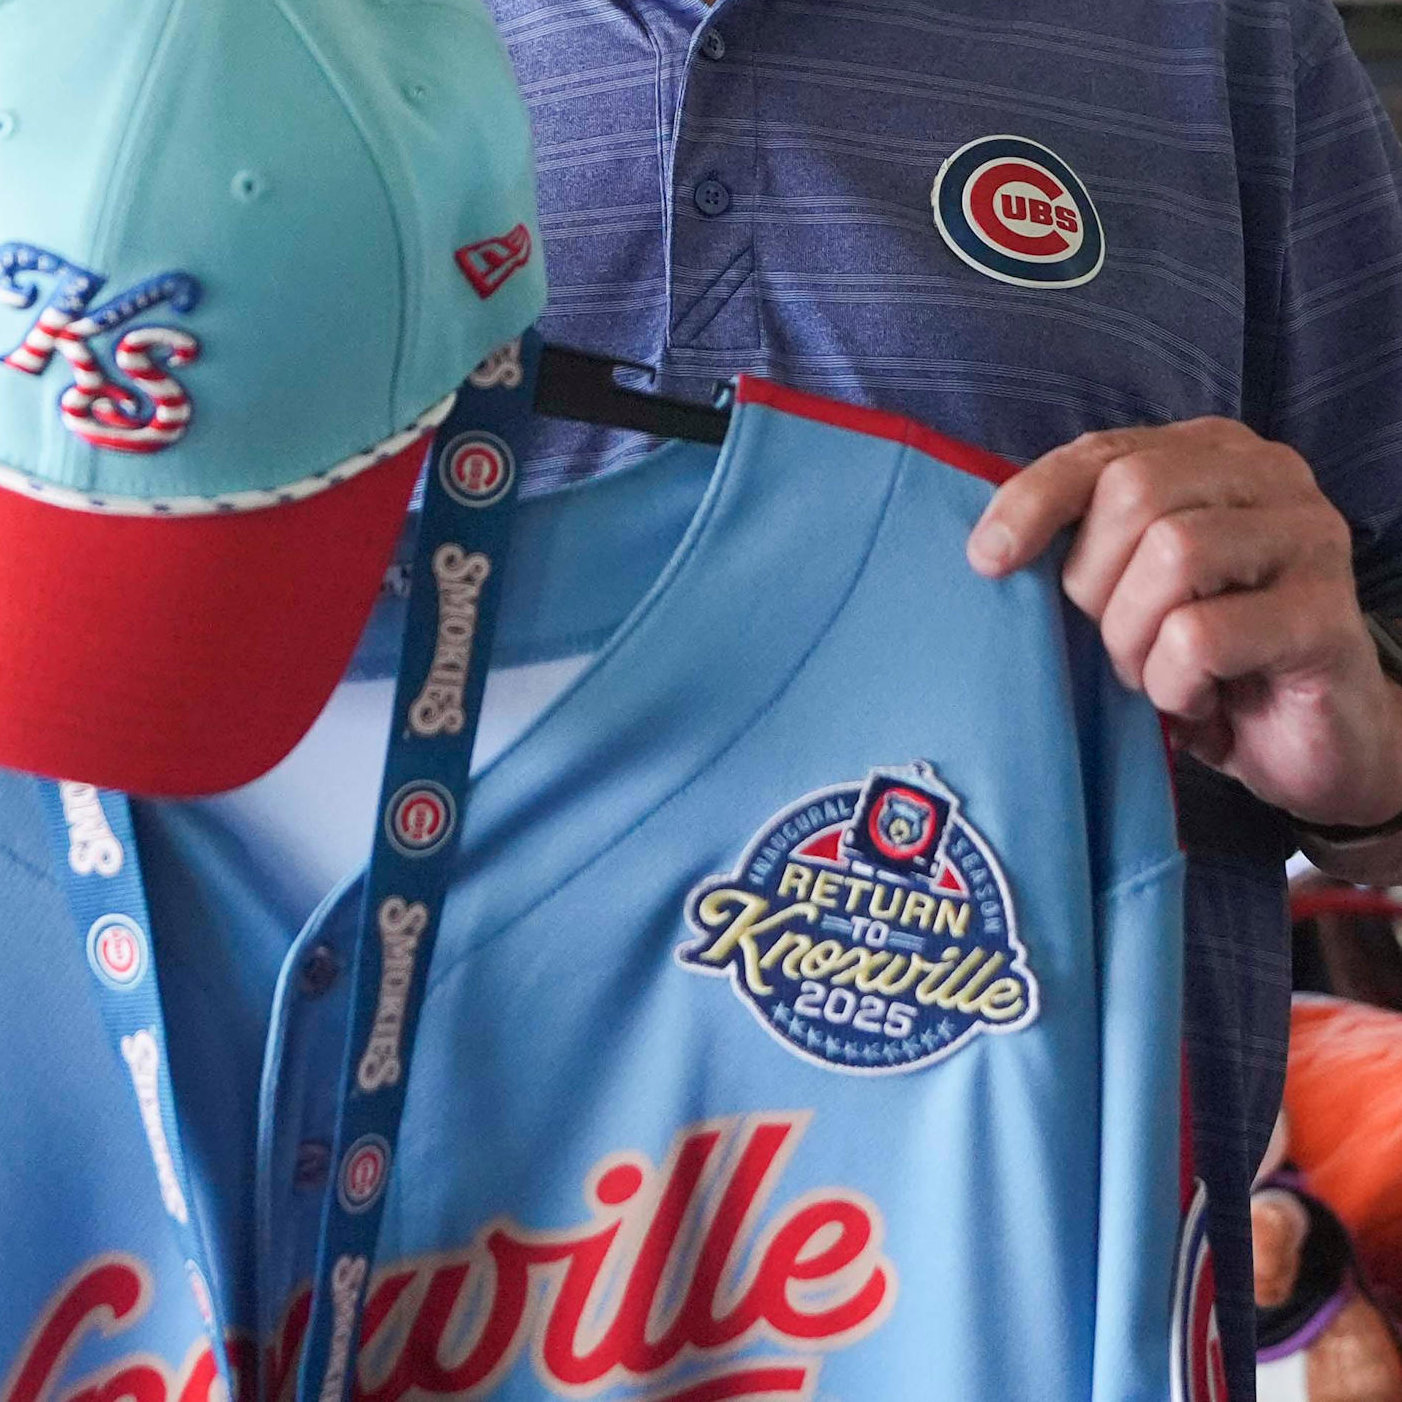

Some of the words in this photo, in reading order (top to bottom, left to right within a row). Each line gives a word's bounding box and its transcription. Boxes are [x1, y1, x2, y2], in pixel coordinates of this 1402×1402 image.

[969, 162, 1079, 256] CUBS
[409, 540, 492, 735] SMOKIES
[749, 795, 851, 887] INAUGURAL
[950, 836, 1003, 935] SEASON
[776, 861, 973, 939] RETURN
[699, 888, 1025, 1021] Knoxville
[849, 915, 892, 948] TO
[793, 979, 919, 1039] 2025
